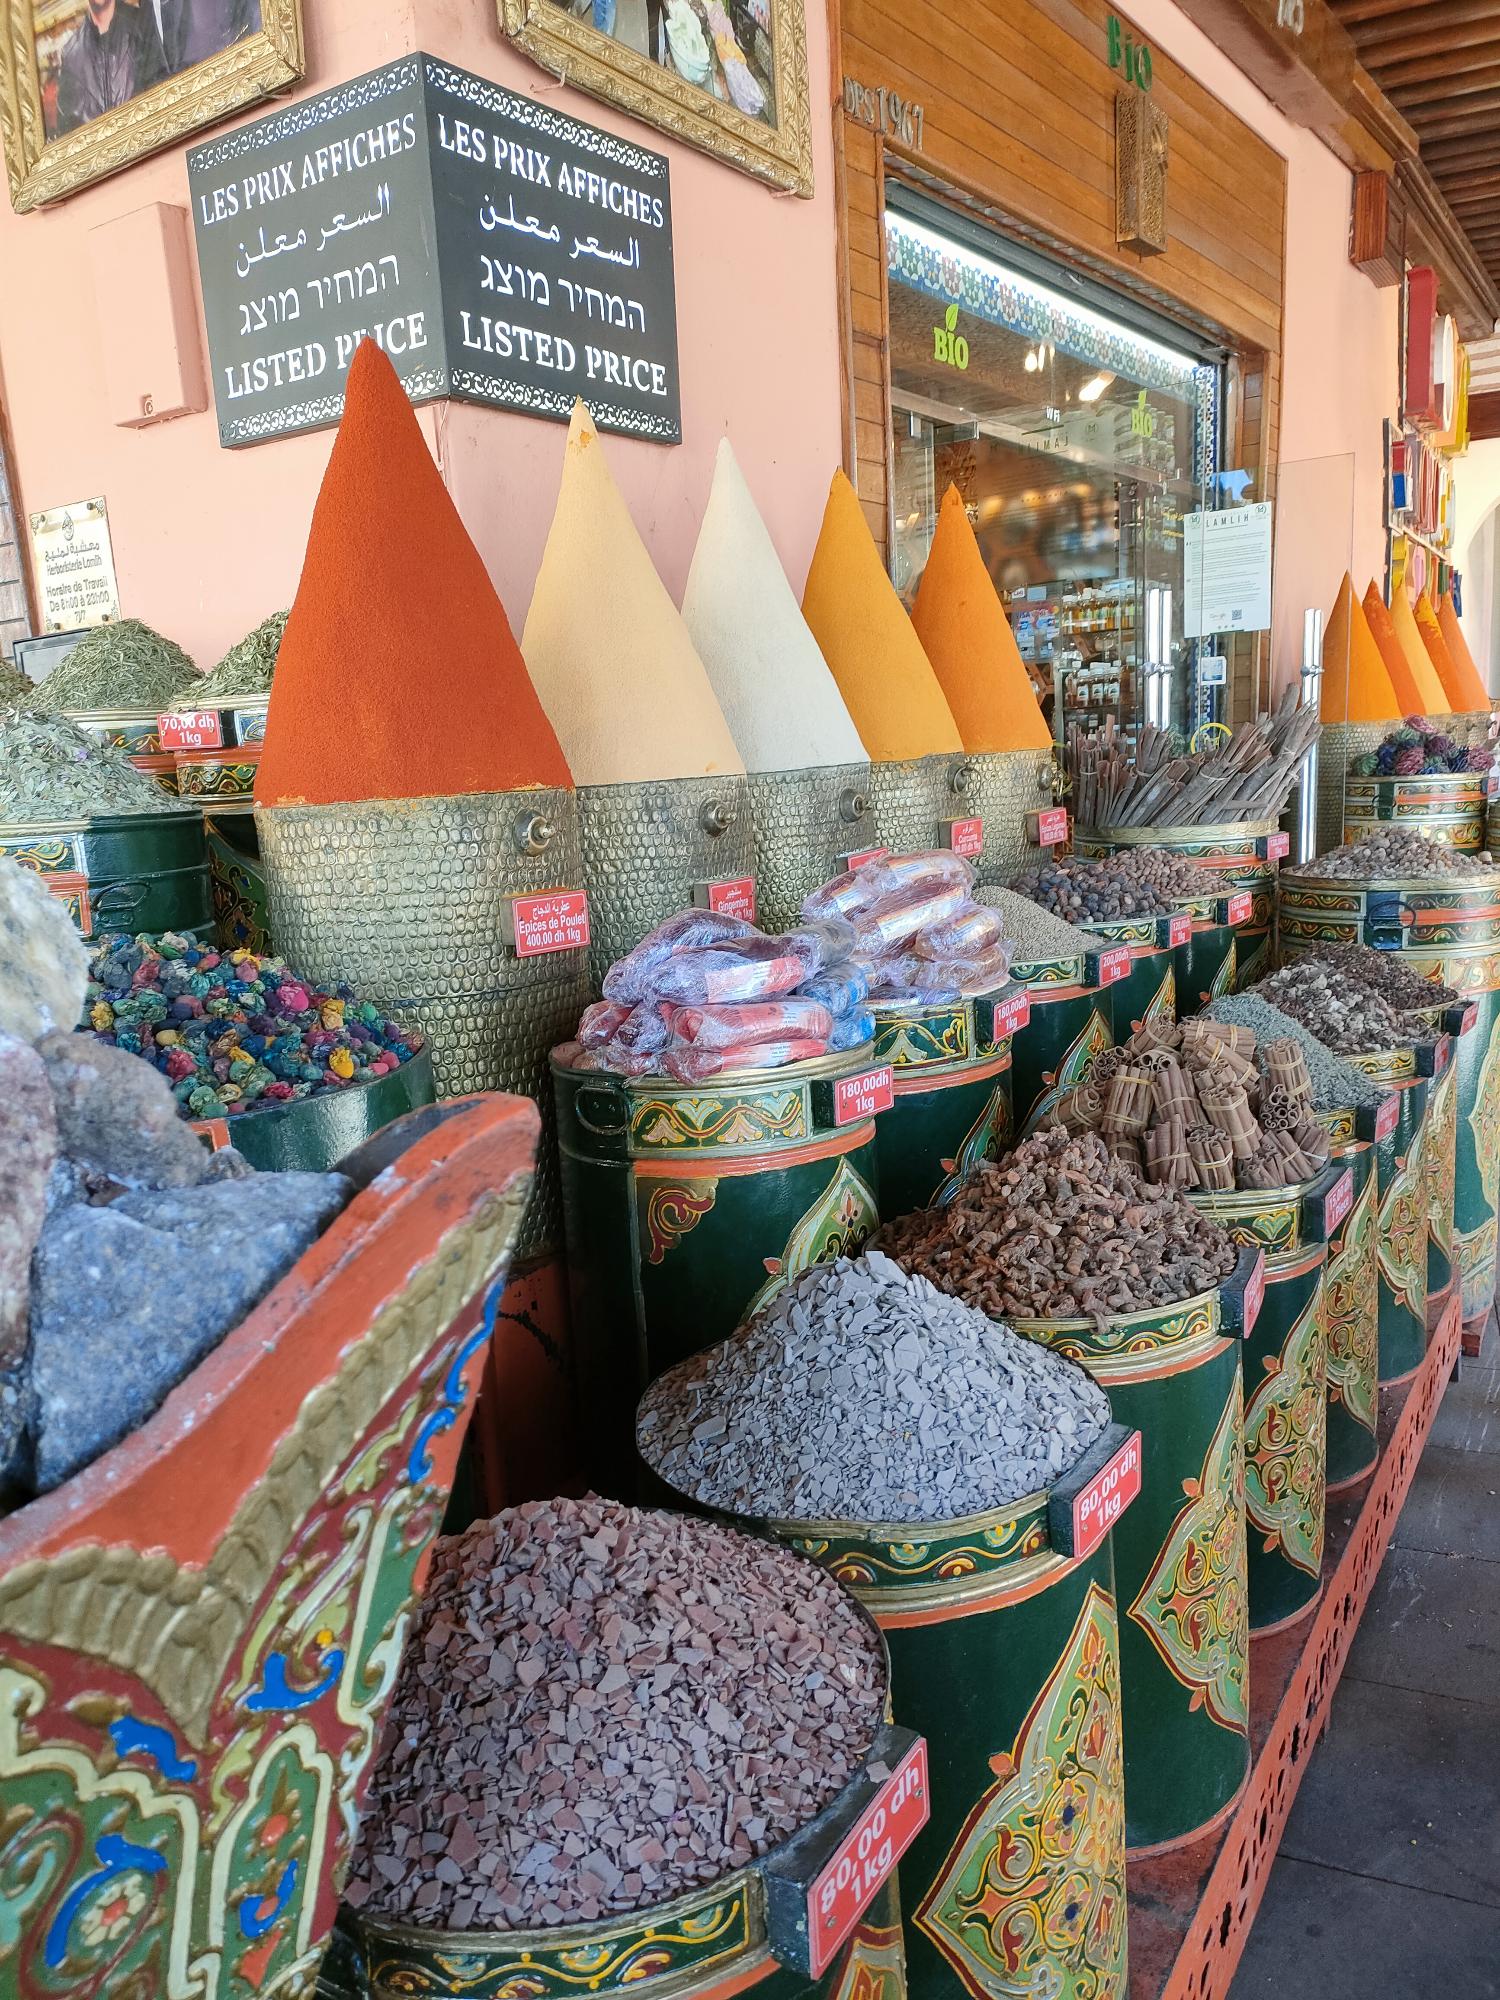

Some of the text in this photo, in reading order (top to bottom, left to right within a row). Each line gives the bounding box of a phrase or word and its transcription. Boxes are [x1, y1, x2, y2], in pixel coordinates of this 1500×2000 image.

[876, 87, 925, 152] 1967
[200, 112, 417, 226] LES PRIX AFFICHES
[437, 113, 664, 229] LES PRIX AFFICHES
[236, 181, 391, 279] السعر معلن
[479, 193, 641, 270] السعر معلن
[239, 254, 400, 336] המחיר מוצג
[480, 254, 646, 333] המחיר מוצג
[459, 310, 669, 397] LISTED PRICE
[933, 325, 970, 371] BIO
[224, 341, 327, 400] LISTED
[46, 575, 109, 598] Horaire de Travail
[49, 599, 61, 613] De
[80, 594, 86, 607] à
[162, 714, 215, 732] 70,00 dh
[179, 730, 203, 746] 1kg
[718, 896, 749, 912] Gingembre
[743, 907, 753, 920] 1kg
[518, 912, 586, 937] Epices de Poulet
[526, 927, 581, 948] 400,00 dh 1kg
[1110, 964, 1121, 979] 1kg
[997, 994, 1028, 1021] 180,00dh
[1005, 1016, 1019, 1031] 1kg
[840, 1070, 890, 1101] 180,00dh
[855, 1095, 876, 1113] 1kg
[1080, 1448, 1137, 1521] 80,00 dh
[1097, 1491, 1121, 1528] 1kg
[820, 1765, 920, 1915] 80,00 dh
[850, 1836, 893, 1904] 1kg
